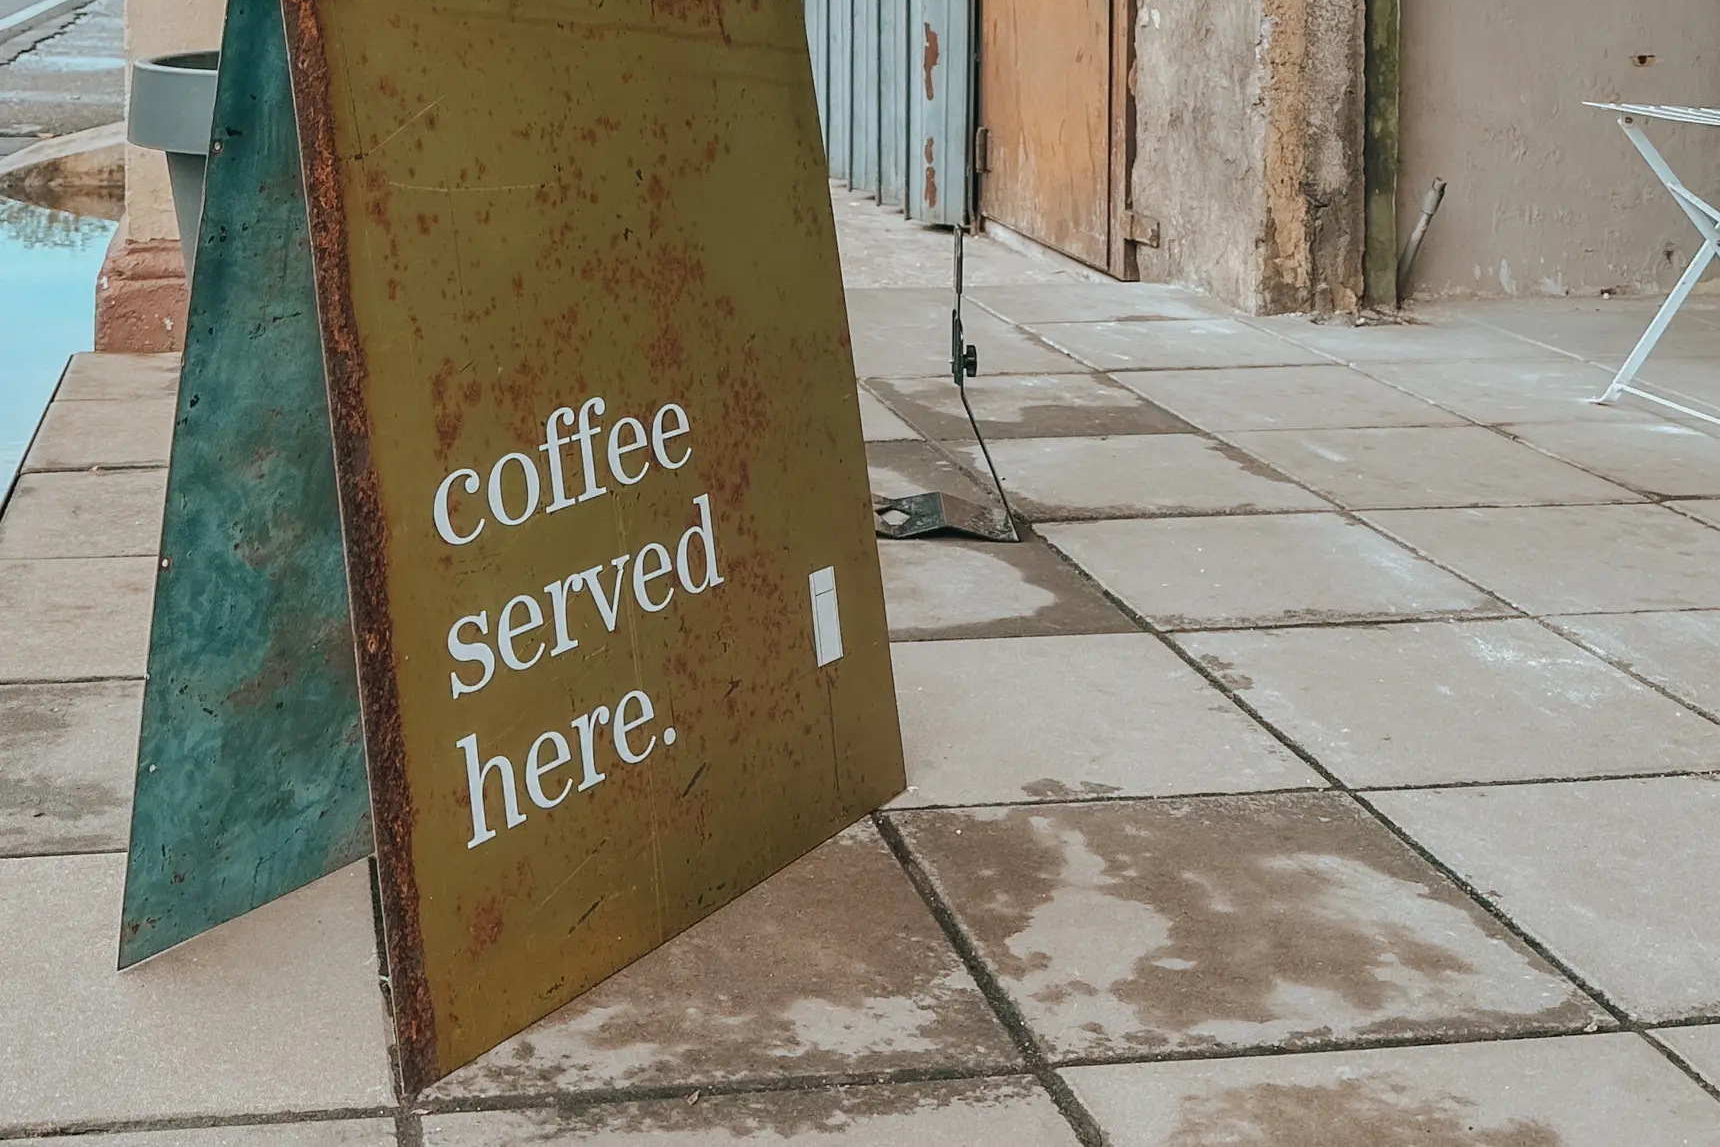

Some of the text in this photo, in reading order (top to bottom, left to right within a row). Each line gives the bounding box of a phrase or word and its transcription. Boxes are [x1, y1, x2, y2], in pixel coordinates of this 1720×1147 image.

[433, 397, 692, 545] coffee
[447, 493, 725, 700] served
[456, 689, 677, 849] here.
